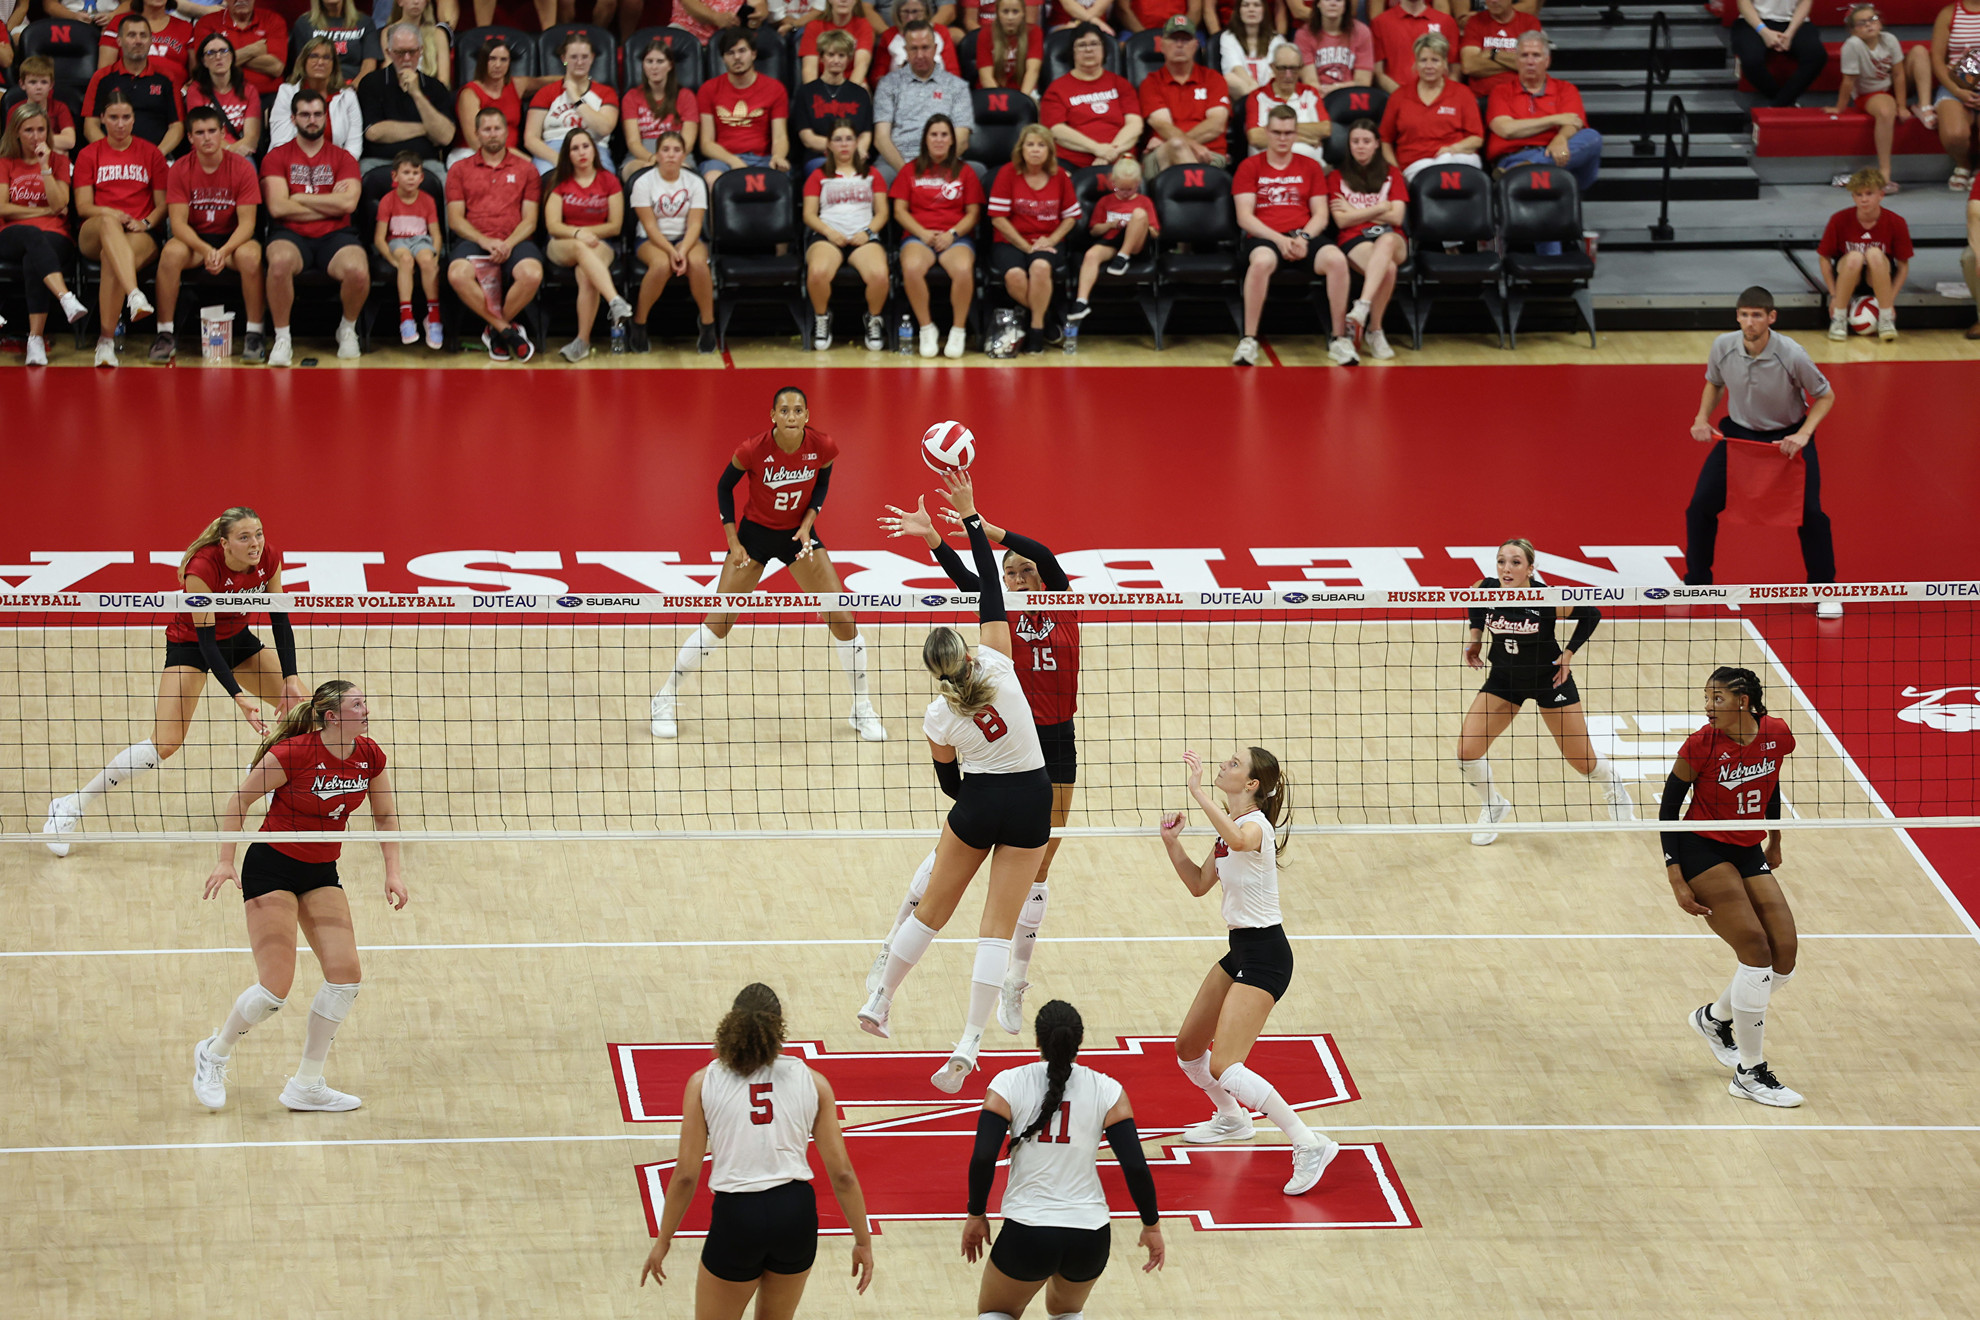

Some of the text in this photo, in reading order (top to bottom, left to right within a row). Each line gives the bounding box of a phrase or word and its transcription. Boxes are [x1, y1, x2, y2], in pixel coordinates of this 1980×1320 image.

[51, 25, 71, 43] N
[150, 84, 161, 95] N
[1194, 88, 1207, 100] N
[988, 93, 1009, 112] N
[1349, 92, 1371, 111] N
[96, 164, 149, 184] NEBRASKA
[1184, 169, 1205, 188] N
[1440, 171, 1461, 190] N
[1531, 171, 1551, 190] N
[745, 174, 766, 193] N
[763, 465, 815, 483] Nebraska
[774, 490, 802, 511] 27
[1200, 592, 1365, 605] DUTEAU SUBARU
[1387, 589, 1545, 603] HUSKER VOLLEYBALL
[1561, 588, 1727, 601] DUTEAU SUBARU
[1748, 585, 1909, 599] HUSKER VOLLEYBALL
[1925, 583, 1980, 597] DUTEA
[0, 595, 81, 607] LLEYBALL
[99, 595, 271, 608] DUTEAU SUBARU
[293, 596, 456, 608] HUSKER VOLLEYBALL
[472, 595, 641, 608] DUTEAU SUBARU
[662, 596, 822, 608] HUSKER VOLLEYBALL
[838, 595, 902, 607] DUTEAU
[1026, 593, 1184, 606] HUSKER VOLLEYBALL
[1485, 612, 1540, 633] Nebraska
[1032, 646, 1057, 671] 15
[973, 704, 1008, 743] 8
[1718, 757, 1776, 782] Nebraska
[311, 774, 370, 791] Nebraska
[1736, 789, 1762, 815] 12
[749, 1083, 773, 1125] 5
[1038, 1101, 1071, 1144] 11
